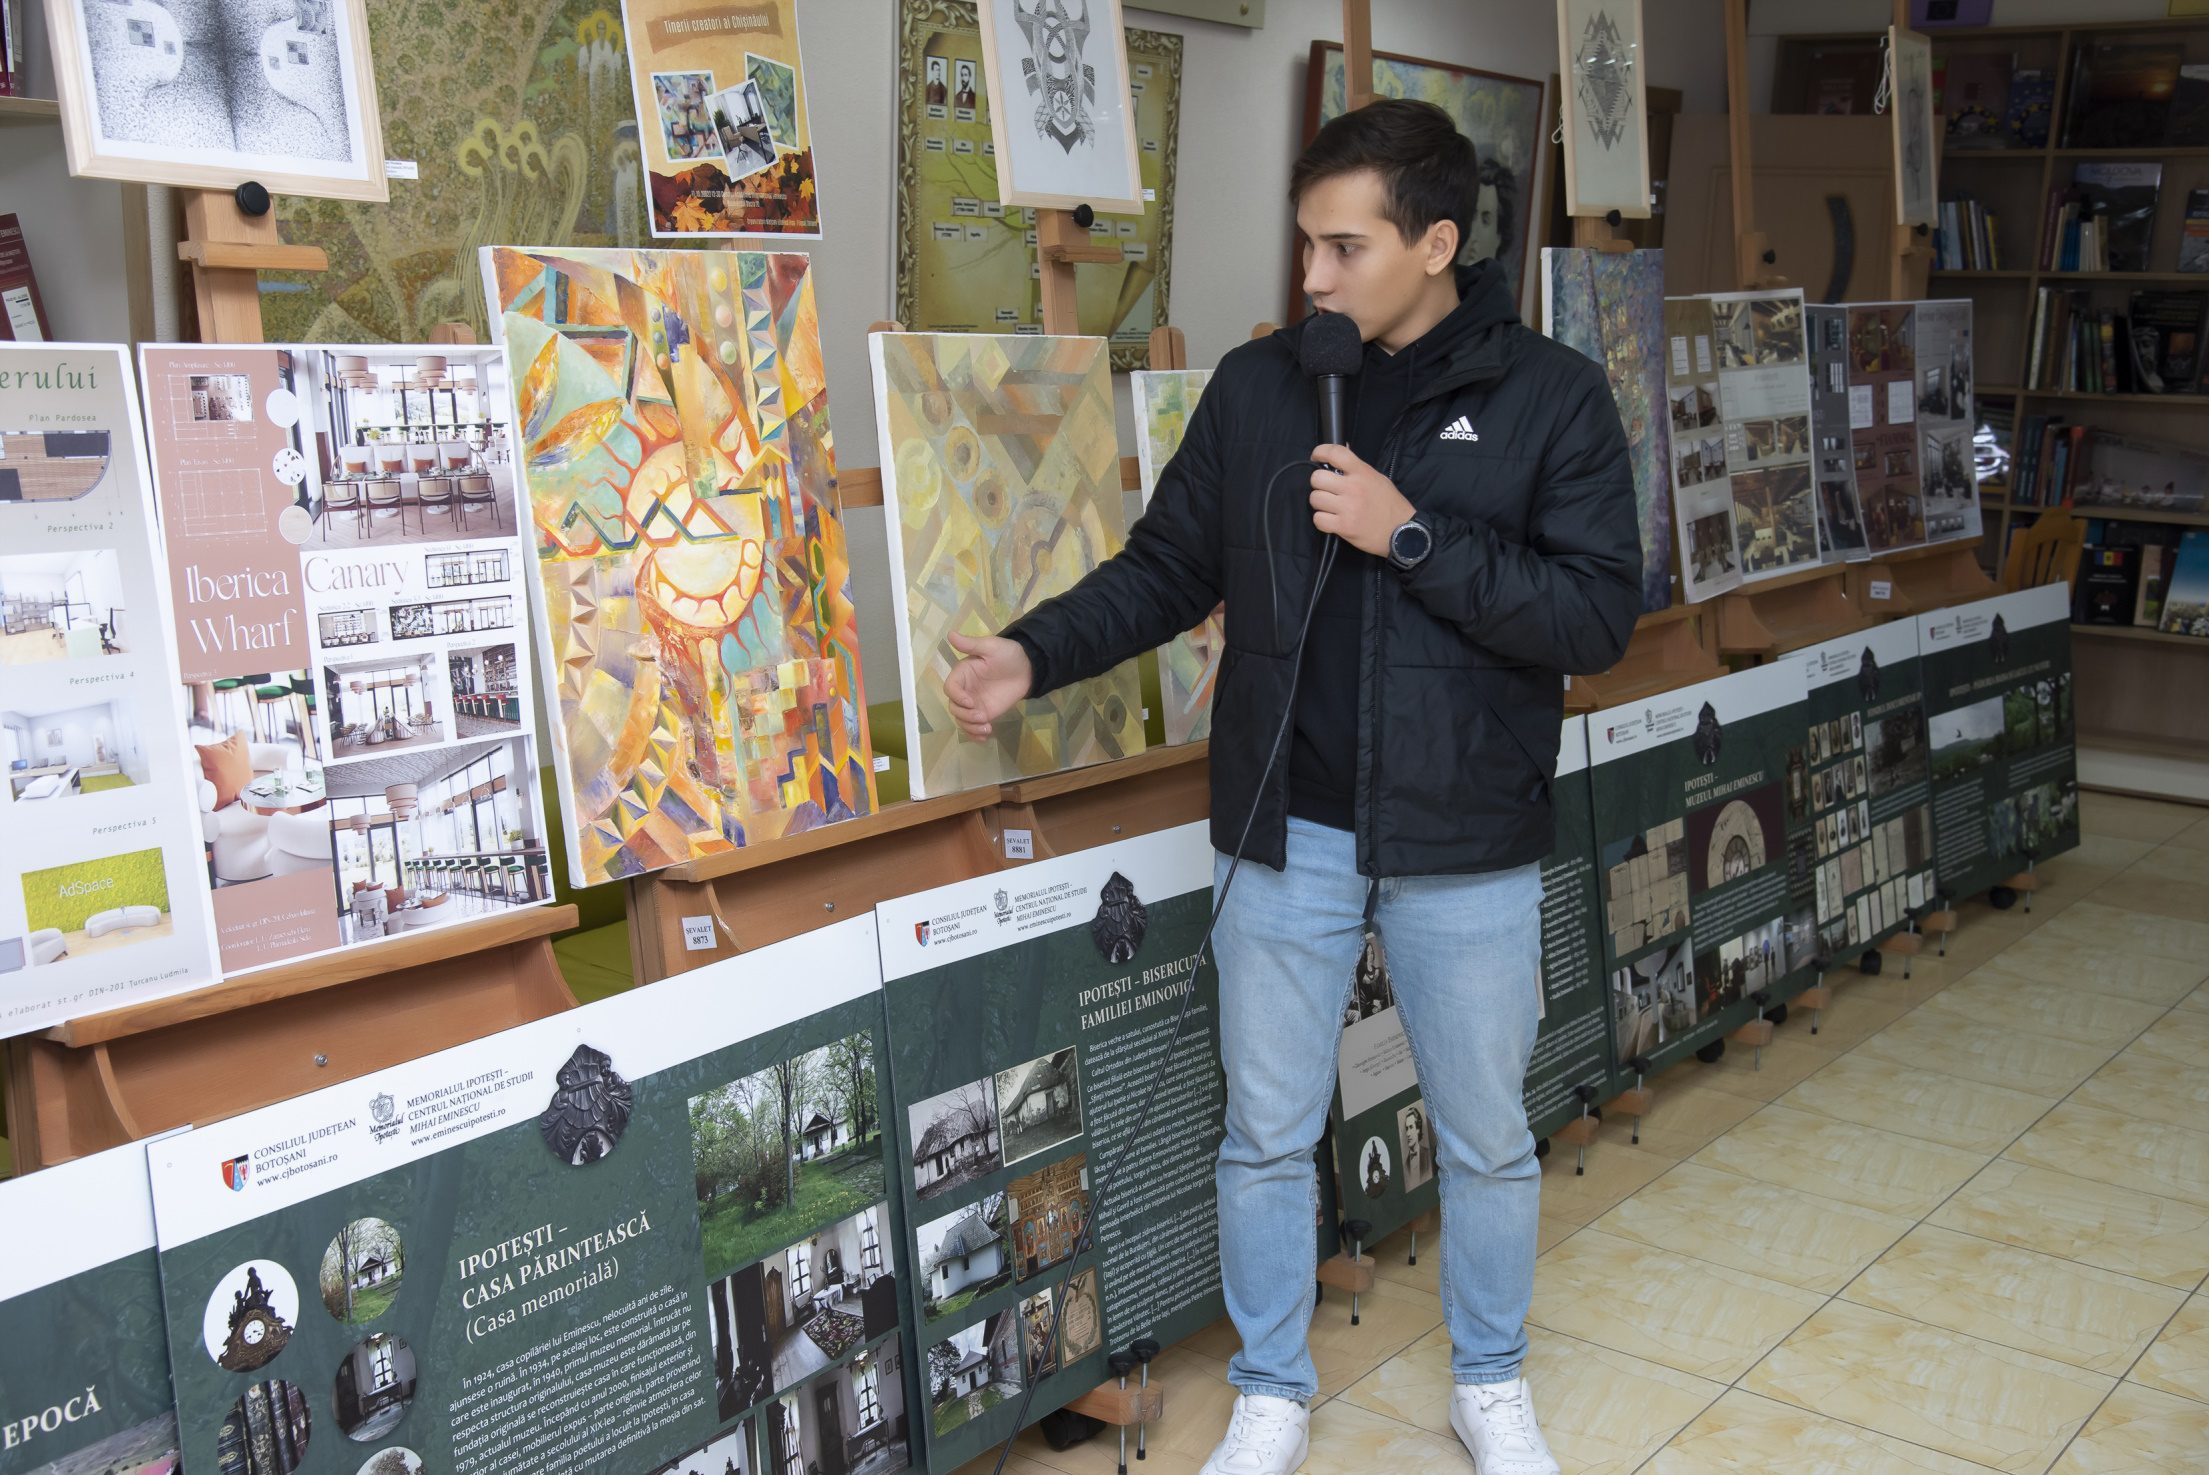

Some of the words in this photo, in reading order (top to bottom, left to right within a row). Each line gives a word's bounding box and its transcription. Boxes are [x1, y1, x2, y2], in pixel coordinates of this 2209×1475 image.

[664, 20, 690, 34] Tinerii
[691, 17, 722, 32] creatori
[723, 17, 731, 28] ai
[56, 414, 97, 422] Pardosea
[1440, 430, 1478, 442] adidas
[48, 524, 103, 533] Perspectiva
[109, 522, 113, 530] 2
[186, 565, 290, 603] Iberica
[304, 556, 409, 595] Canary
[191, 608, 297, 654] Wharf
[70, 673, 125, 685] Perspectiva
[1684, 772, 1713, 791] IPOTEȘTI
[93, 820, 147, 835] Perspectiva
[152, 817, 157, 825] 5
[59, 876, 113, 898] AdSpace
[1014, 888, 1046, 902] MEMORIALUL
[1015, 900, 1038, 913] CENTRUL
[1064, 890, 1073, 899] DE
[685, 926, 711, 934] SEVALET
[931, 911, 961, 926] CONSILIUL
[960, 904, 987, 919] JUDEȚEAN
[1016, 911, 1032, 921] MIHAI
[1032, 904, 1056, 918] EMINESCU
[692, 936, 708, 944] 8873
[8, 1001, 51, 1017] elaborat
[89, 982, 125, 997] DIN-201
[129, 975, 158, 988] Turcanu
[161, 968, 188, 980] Ludmila
[1078, 975, 1132, 1007] IPOTEȘTI
[1080, 999, 1132, 1030] FAMILIEI
[406, 1082, 465, 1108] MEMORIALUL
[466, 1068, 503, 1088] IPOTEȘTI
[407, 1100, 448, 1121] CENTRUL
[449, 1085, 493, 1107] NAȚIONAL
[494, 1080, 506, 1092] DE
[506, 1070, 533, 1088] STUDII
[368, 1114, 403, 1134] Memorialul
[409, 1117, 436, 1134] MIHAI
[438, 1102, 480, 1124] EMINESCU
[410, 1108, 506, 1146] www.eminescuipotesti.ro
[253, 1135, 307, 1160] CONSILIUL
[308, 1118, 356, 1144] JUDEȚEAN
[255, 1148, 306, 1174] BOTOȘANI
[256, 1153, 338, 1186] www.cjbotosani.ro
[458, 1223, 553, 1280] IPOTEȘTI
[462, 1272, 515, 1309] CASA
[519, 1209, 651, 1286] PĂRINTEASCĂ
[466, 1308, 516, 1344] (Casa
[521, 1256, 618, 1316] memorială)
[449, 1388, 486, 1412] ajunsese
[494, 1371, 518, 1390] ruină.
[518, 1366, 528, 1378] În
[528, 1358, 550, 1374] 1934,
[550, 1352, 561, 1366] pe
[562, 1337, 588, 1358] același
[588, 1333, 603, 1344] loc,
[603, 1324, 620, 1337] este
[620, 1304, 657, 1329] construită
[664, 1293, 680, 1308] casă
[680, 1291, 688, 1300] în
[462, 1377, 472, 1389] În
[473, 1369, 495, 1385] 1924,
[495, 1359, 514, 1373] casa
[515, 1339, 551, 1364] copilăriei
[552, 1334, 562, 1347] lui
[563, 1319, 602, 1342] Eminescu,
[602, 1299, 636, 1323] nelocuită
[637, 1293, 648, 1307] ani
[649, 1290, 659, 1301] de
[659, 1284, 674, 1296] zile,
[450, 1412, 469, 1427] care
[470, 1402, 489, 1417] este
[490, 1382, 532, 1407] inaugurat,
[532, 1377, 541, 1387] în
[541, 1367, 563, 1383] 1940,
[563, 1351, 589, 1374] primul
[589, 1341, 616, 1359] muzeu
[616, 1321, 652, 1346] memorial.
[652, 1308, 682, 1328] Întrucât
[682, 1304, 692, 1314] nu
[452, 1418, 489, 1442] respecta
[490, 1399, 527, 1424] structura
[528, 1375, 574, 1404] originalului,
[575, 1354, 619, 1381] casa-muzeu
[619, 1346, 636, 1359] este
[636, 1326, 671, 1351] dărâmată
[671, 1323, 681, 1334] iar
[681, 1318, 691, 1331] pe
[453, 1434, 489, 1457] fundația
[490, 1413, 526, 1439] originală
[537, 1382, 593, 1415] reconstruiește
[593, 1373, 611, 1387] casa
[610, 1368, 619, 1378] în
[619, 1360, 636, 1374] care
[636, 1335, 685, 1365] funcționează,
[685, 1330, 697, 1341] din
[455, 1456, 478, 1473] 1979,
[478, 1435, 511, 1461] actualul
[512, 1424, 542, 1443] muzeu.
[542, 1401, 579, 1428] Începând
[591, 1387, 607, 1404] anul
[608, 1379, 629, 1395] 2000,
[630, 1361, 658, 1383] finisajul
[658, 1349, 686, 1369] exterior
[498, 1450, 521, 1466] casei,
[522, 1425, 562, 1454] mobilierul
[563, 1415, 587, 1433] expus
[593, 1401, 614, 1420] parte
[614, 1384, 645, 1406] original,
[645, 1375, 665, 1393] parte
[665, 1354, 701, 1383] provenind
[2, 1385, 102, 1449] EPOCĂ
[545, 1453, 572, 1472] familia
[572, 1433, 605, 1461] poetului
[611, 1420, 632, 1437] locuit
[641, 1400, 671, 1423] Ipotești,
[679, 1388, 695, 1401] casa
[546, 1433, 581, 1457] secolului
[589, 1415, 616, 1434] XIX-lea
[622, 1398, 647, 1417] reînvie
[648, 1379, 684, 1404] atmosfera
[684, 1369, 702, 1384] celor
[584, 1444, 616, 1467] mutarea
[617, 1424, 651, 1449] definitivă
[659, 1410, 681, 1427] moșia
[681, 1403, 693, 1415] din
[693, 1396, 706, 1409] sat.
